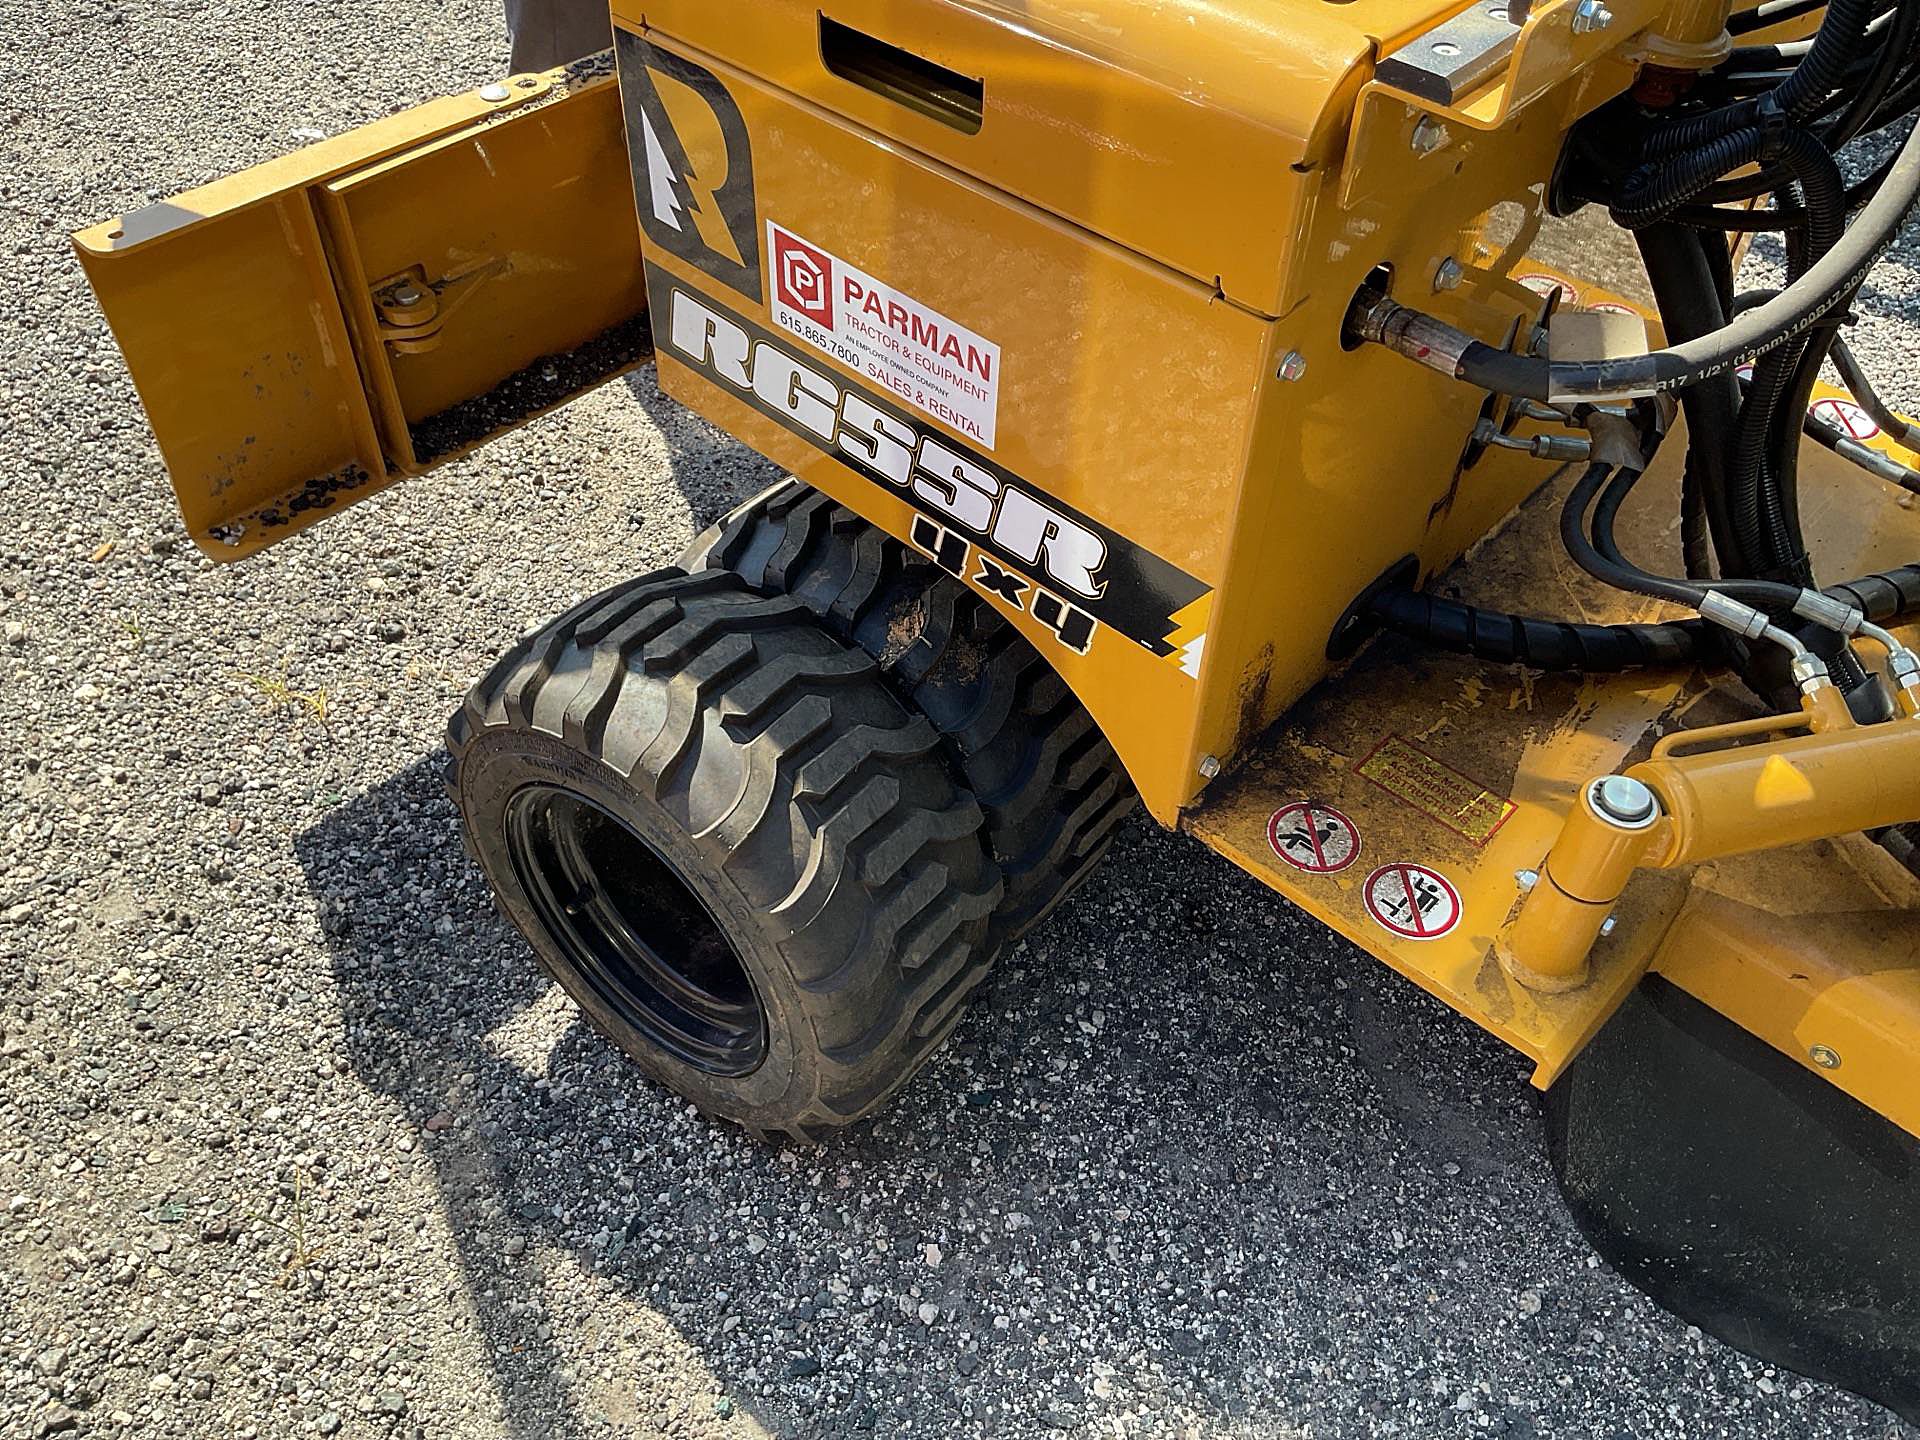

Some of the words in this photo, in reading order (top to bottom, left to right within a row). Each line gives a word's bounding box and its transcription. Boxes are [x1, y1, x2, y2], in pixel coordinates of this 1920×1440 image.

[780, 311, 860, 368] 615.865.7800
[844, 275, 991, 383] PARMAN
[844, 312, 900, 353] TRACTOR
[902, 346, 912, 361] &
[914, 354, 989, 403] EQUIPMENT
[845, 334, 856, 345] AN
[855, 339, 890, 364] EMPLOYEE
[889, 360, 916, 379] OWNED
[915, 374, 950, 398] COMPANY
[867, 362, 913, 398] SALES
[916, 390, 926, 406] &
[928, 397, 985, 441] RENTAL
